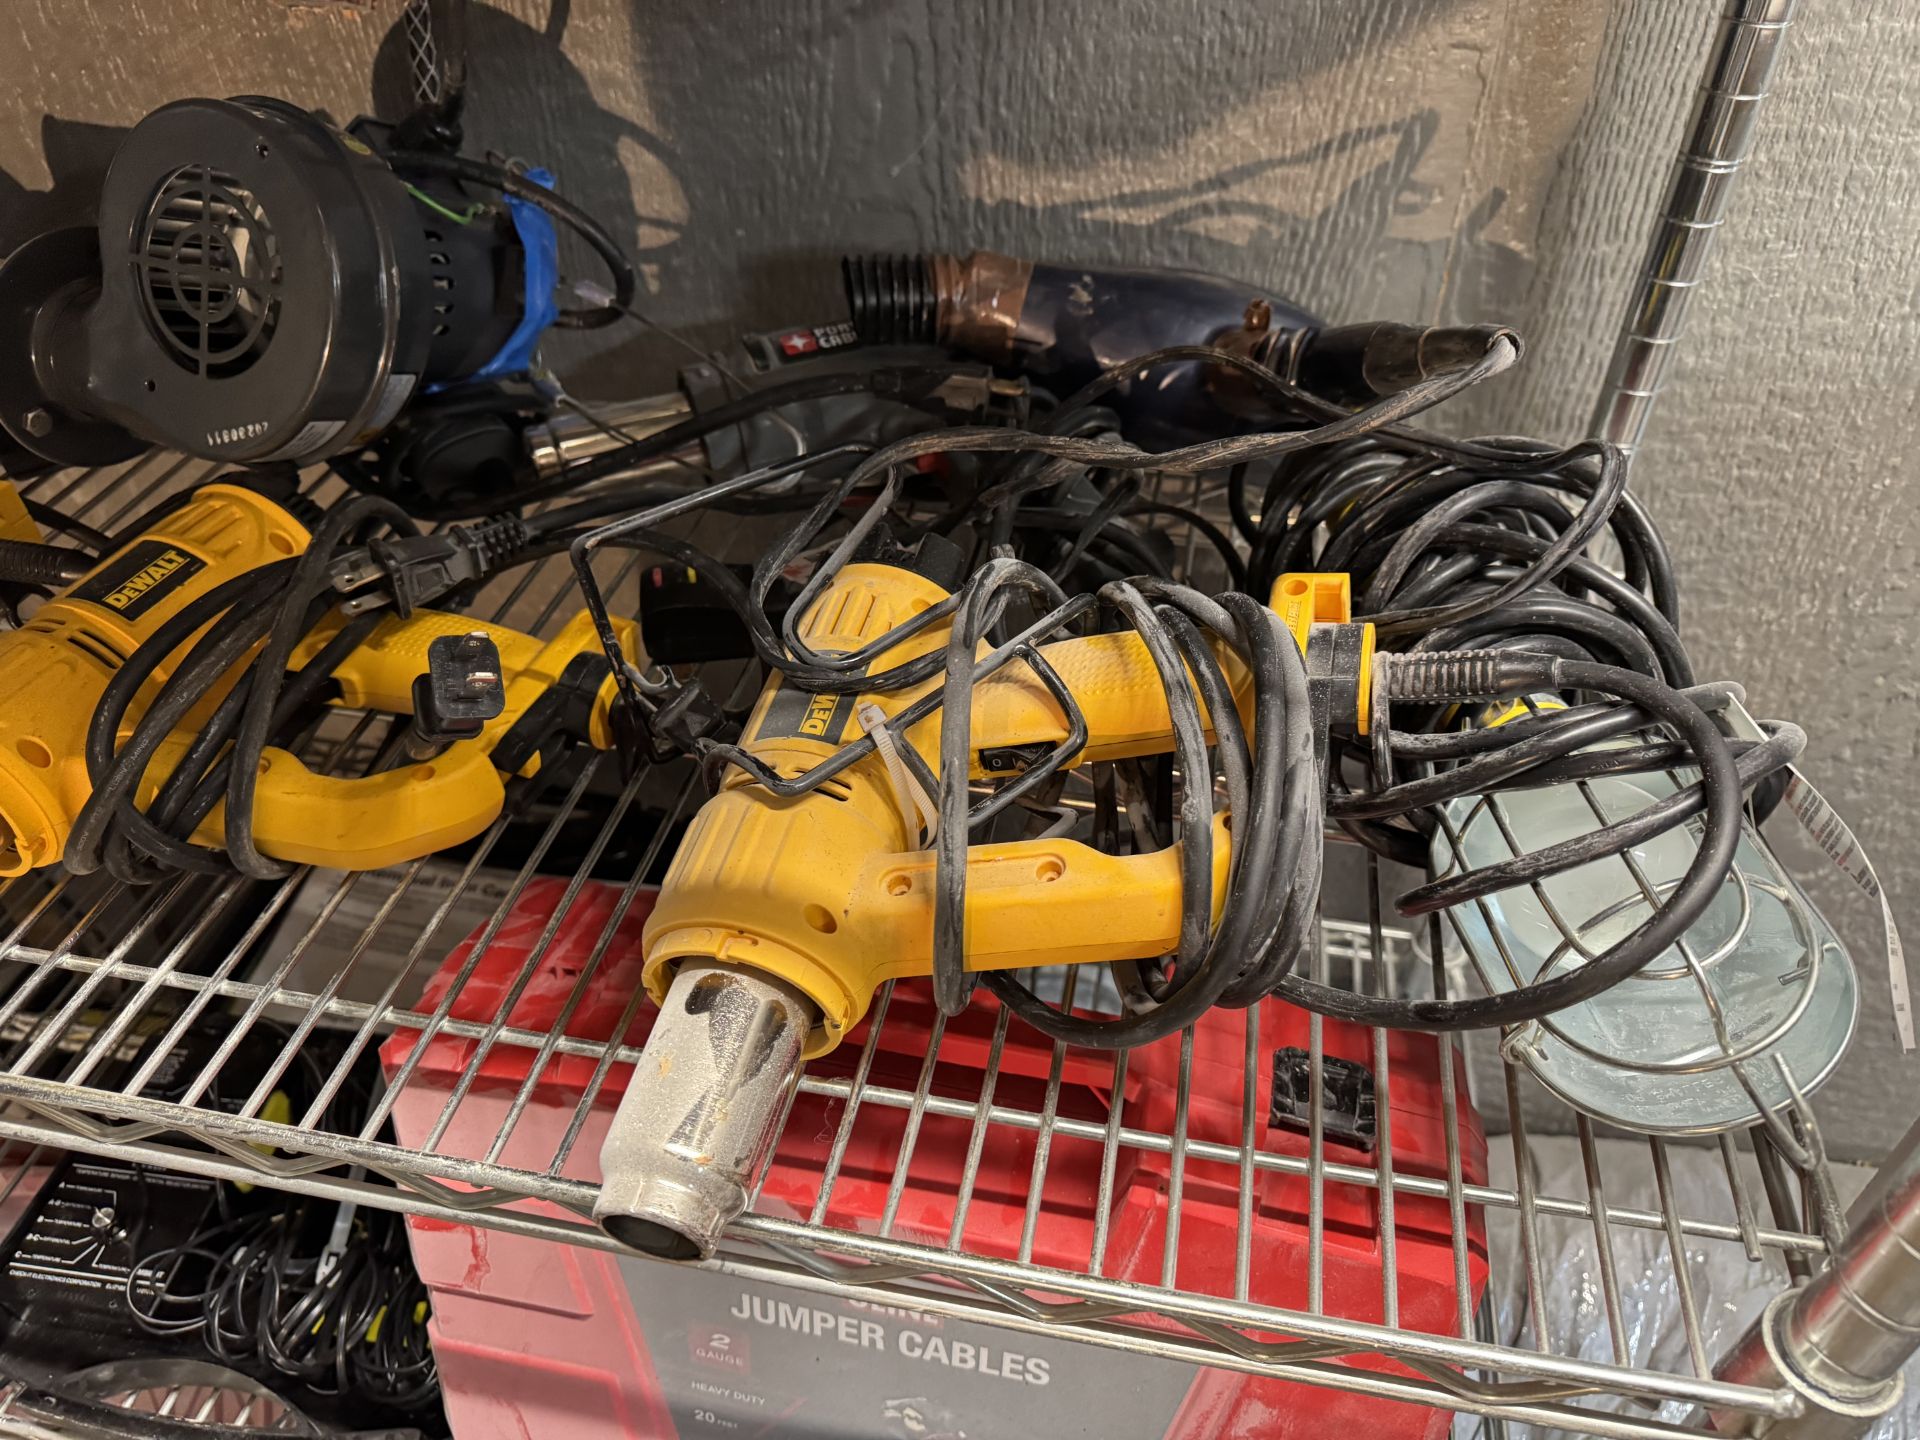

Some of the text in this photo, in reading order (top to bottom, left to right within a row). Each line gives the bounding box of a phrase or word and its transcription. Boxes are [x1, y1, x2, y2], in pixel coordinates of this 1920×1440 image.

[800, 694, 838, 736] DEW
[709, 1333, 731, 1350] 2
[730, 1293, 1051, 1385] JUMPER CABLES
[695, 1347, 744, 1367] GAUGE
[691, 1380, 766, 1406] HEAVY DUTY
[694, 1409, 716, 1424] 20
